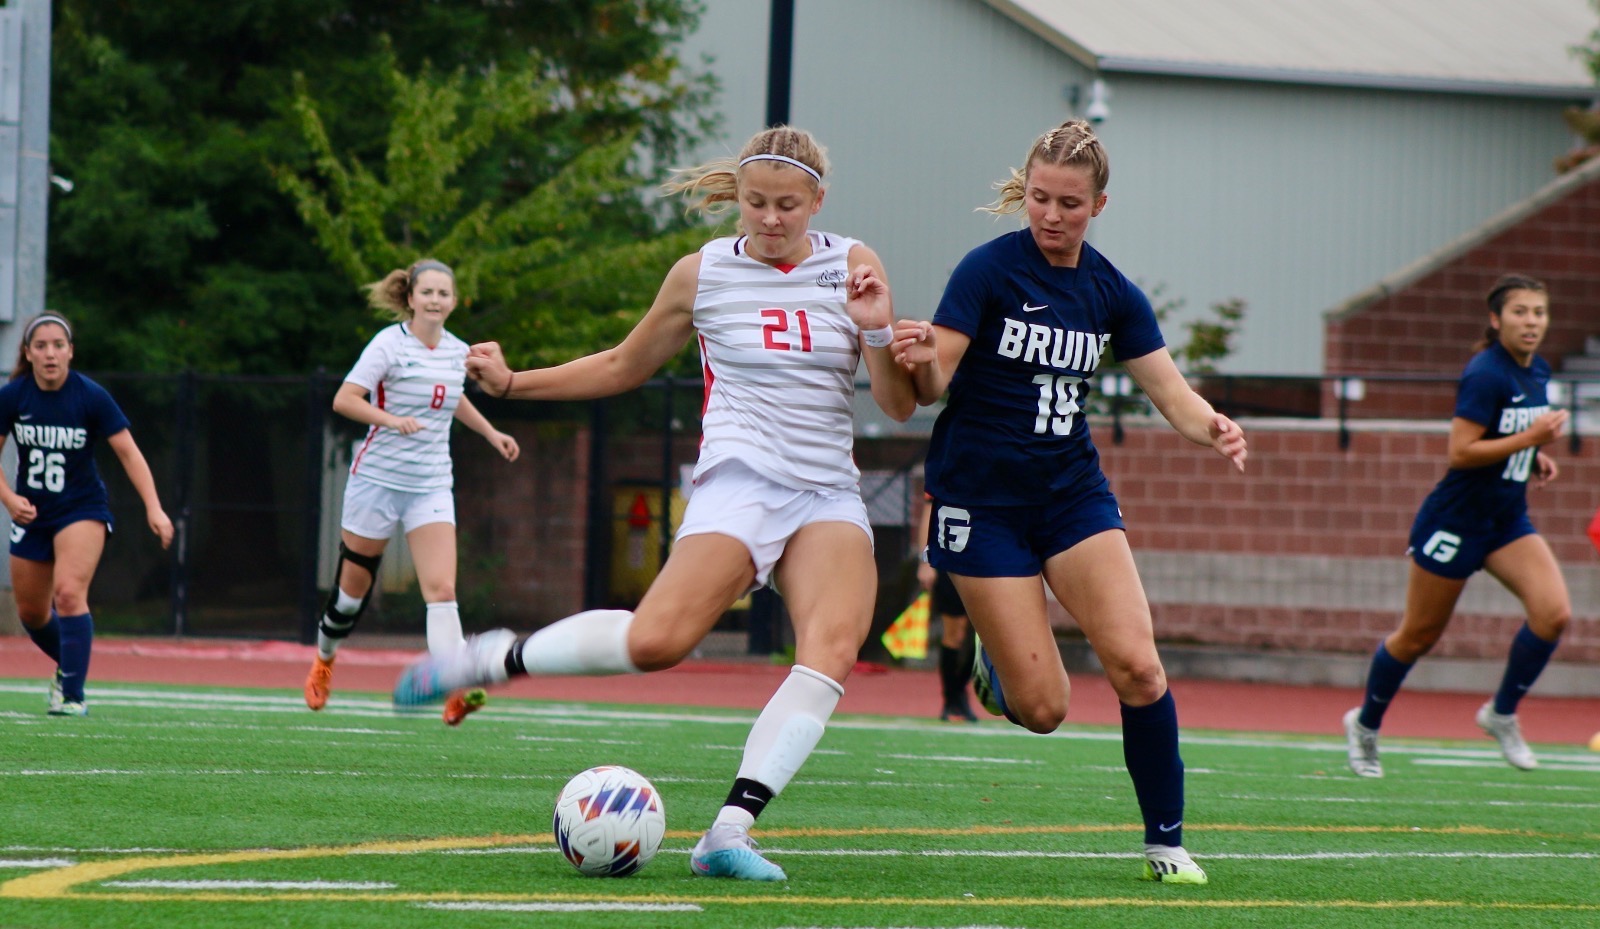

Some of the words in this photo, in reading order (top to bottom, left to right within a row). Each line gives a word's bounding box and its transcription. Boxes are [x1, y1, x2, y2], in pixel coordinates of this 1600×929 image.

[760, 308, 813, 353] 21
[997, 317, 1111, 372] BRUIN
[430, 384, 446, 410] 8
[1032, 374, 1080, 436] 19
[14, 422, 87, 449] BRUINS
[27, 448, 66, 493] 26
